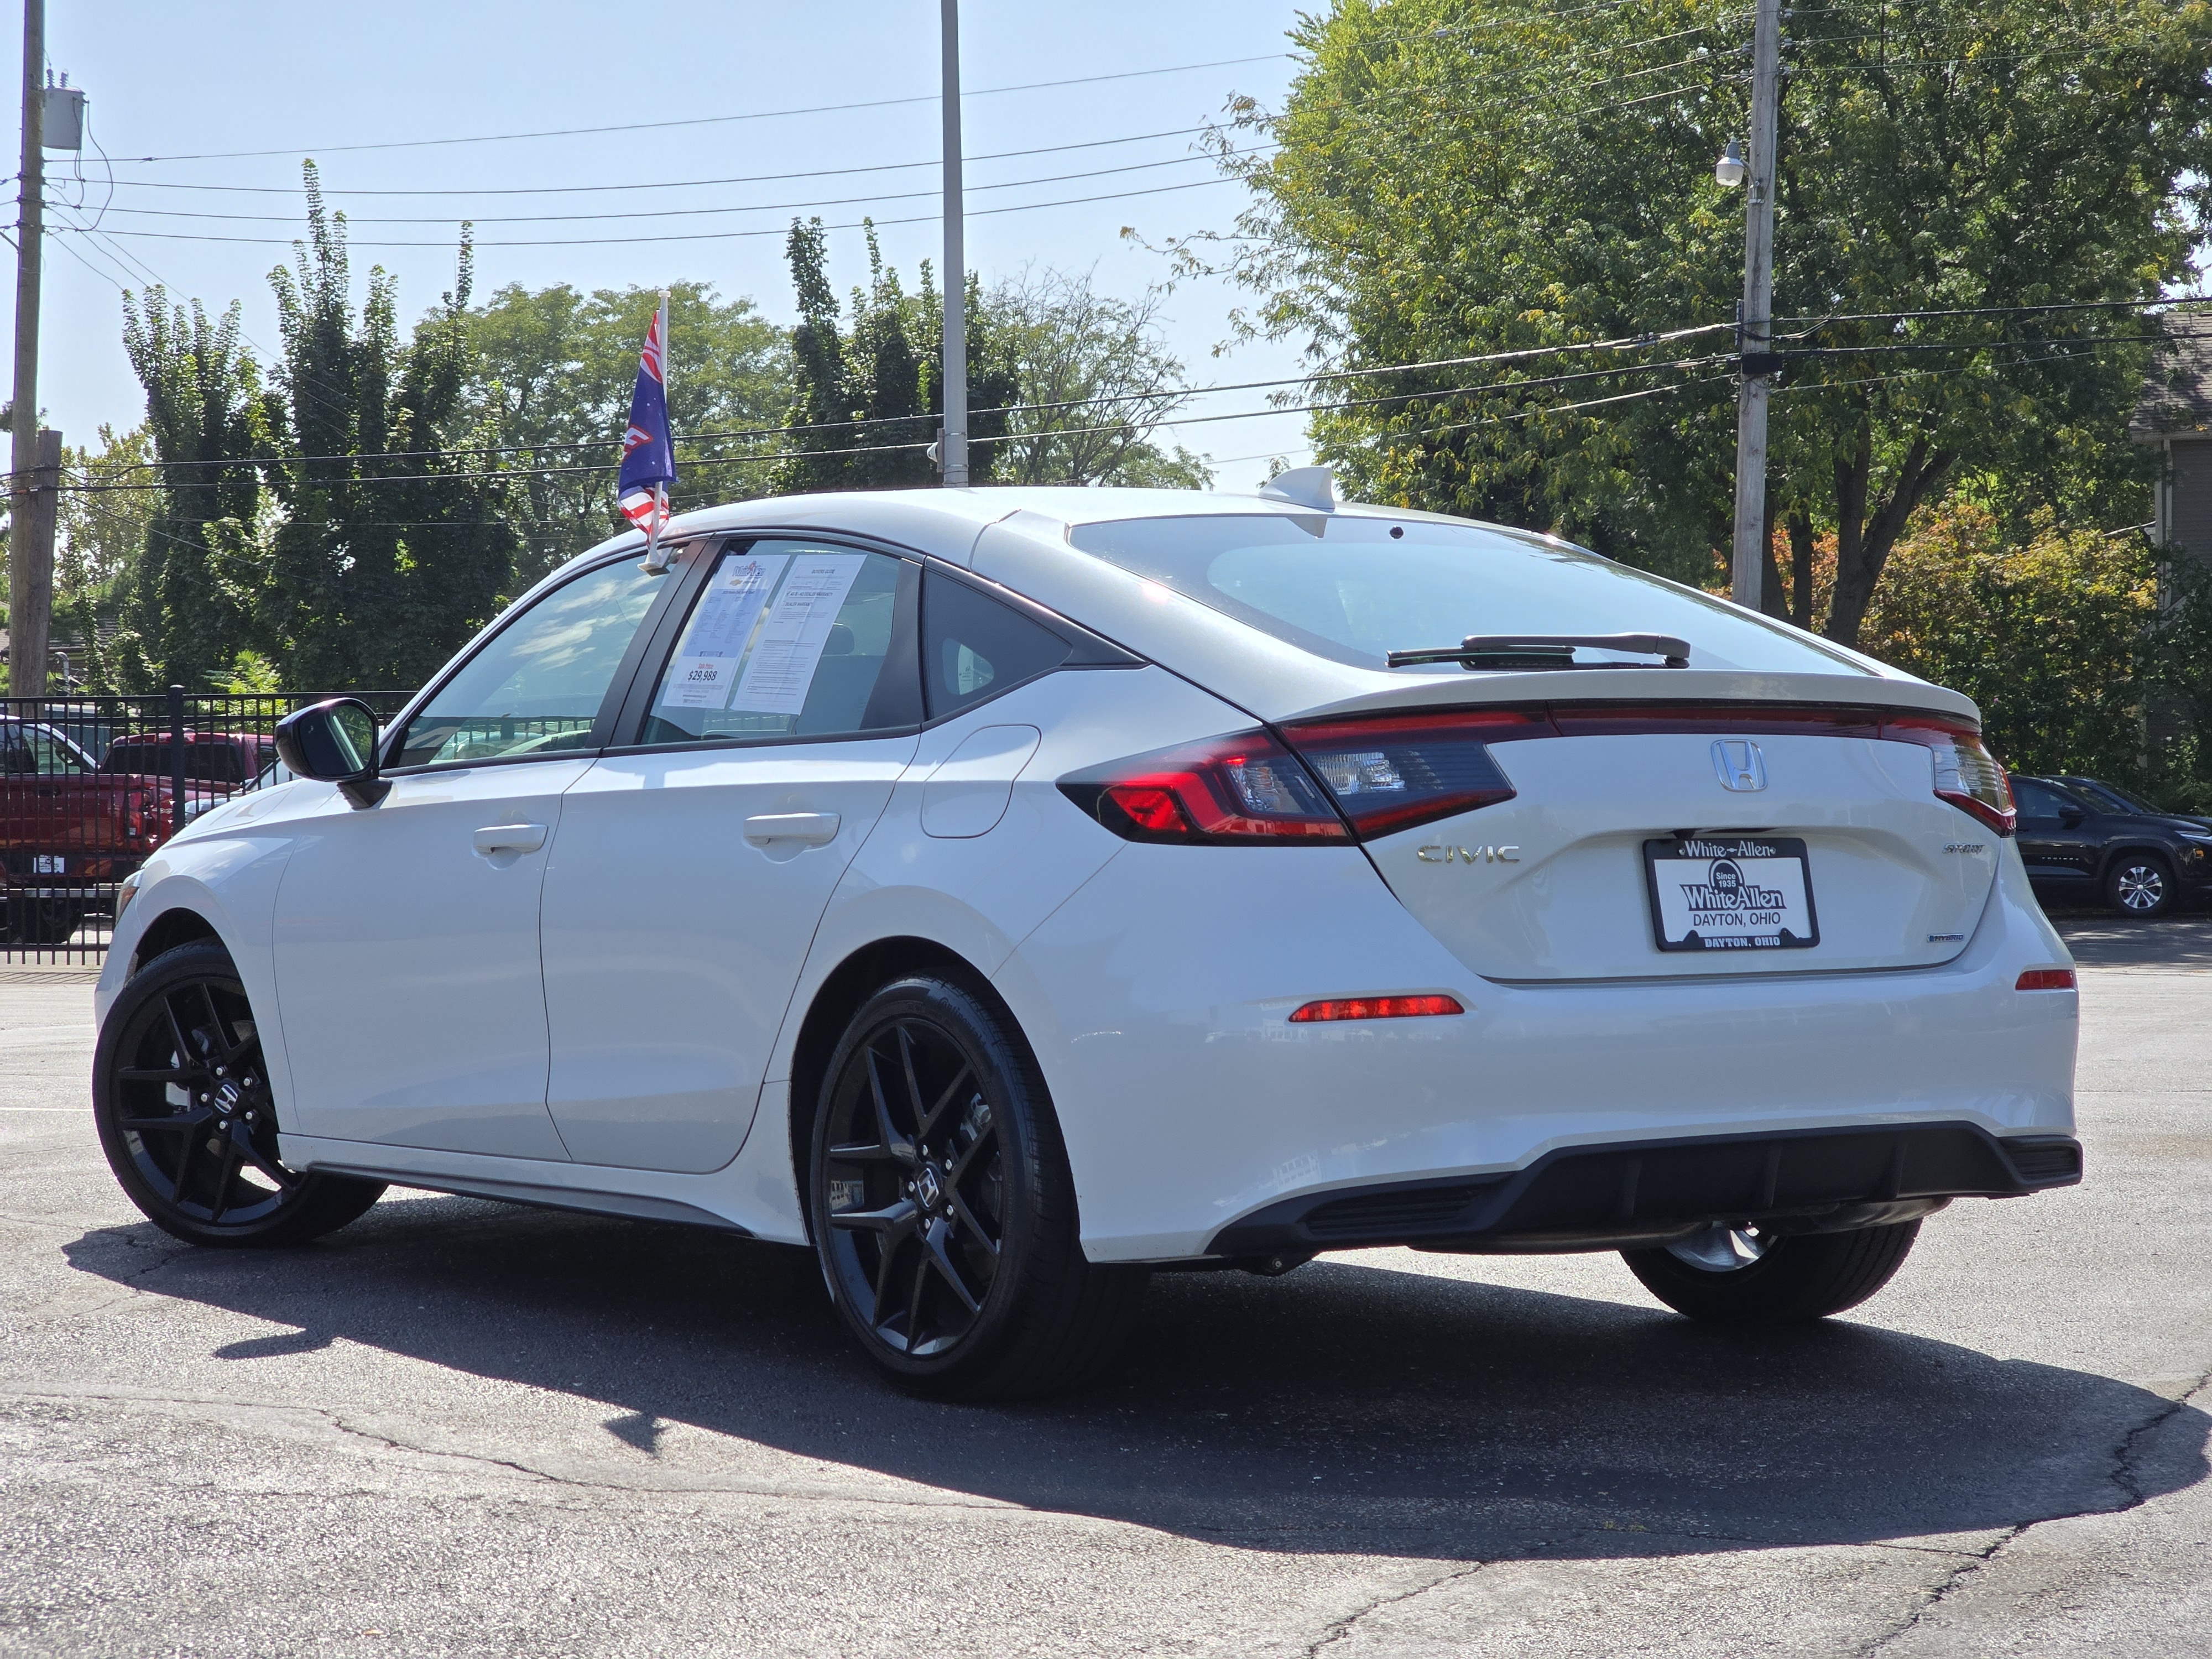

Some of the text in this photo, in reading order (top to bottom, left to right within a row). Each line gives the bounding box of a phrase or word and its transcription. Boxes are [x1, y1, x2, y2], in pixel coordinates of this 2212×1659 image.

[687, 670, 718, 682] $29,988
[1417, 845, 1520, 864] CIVIC
[1716, 872, 1736, 880] Since
[1693, 912, 1781, 927] DAYTON, OHIO
[1755, 937, 1780, 946] OHIO
